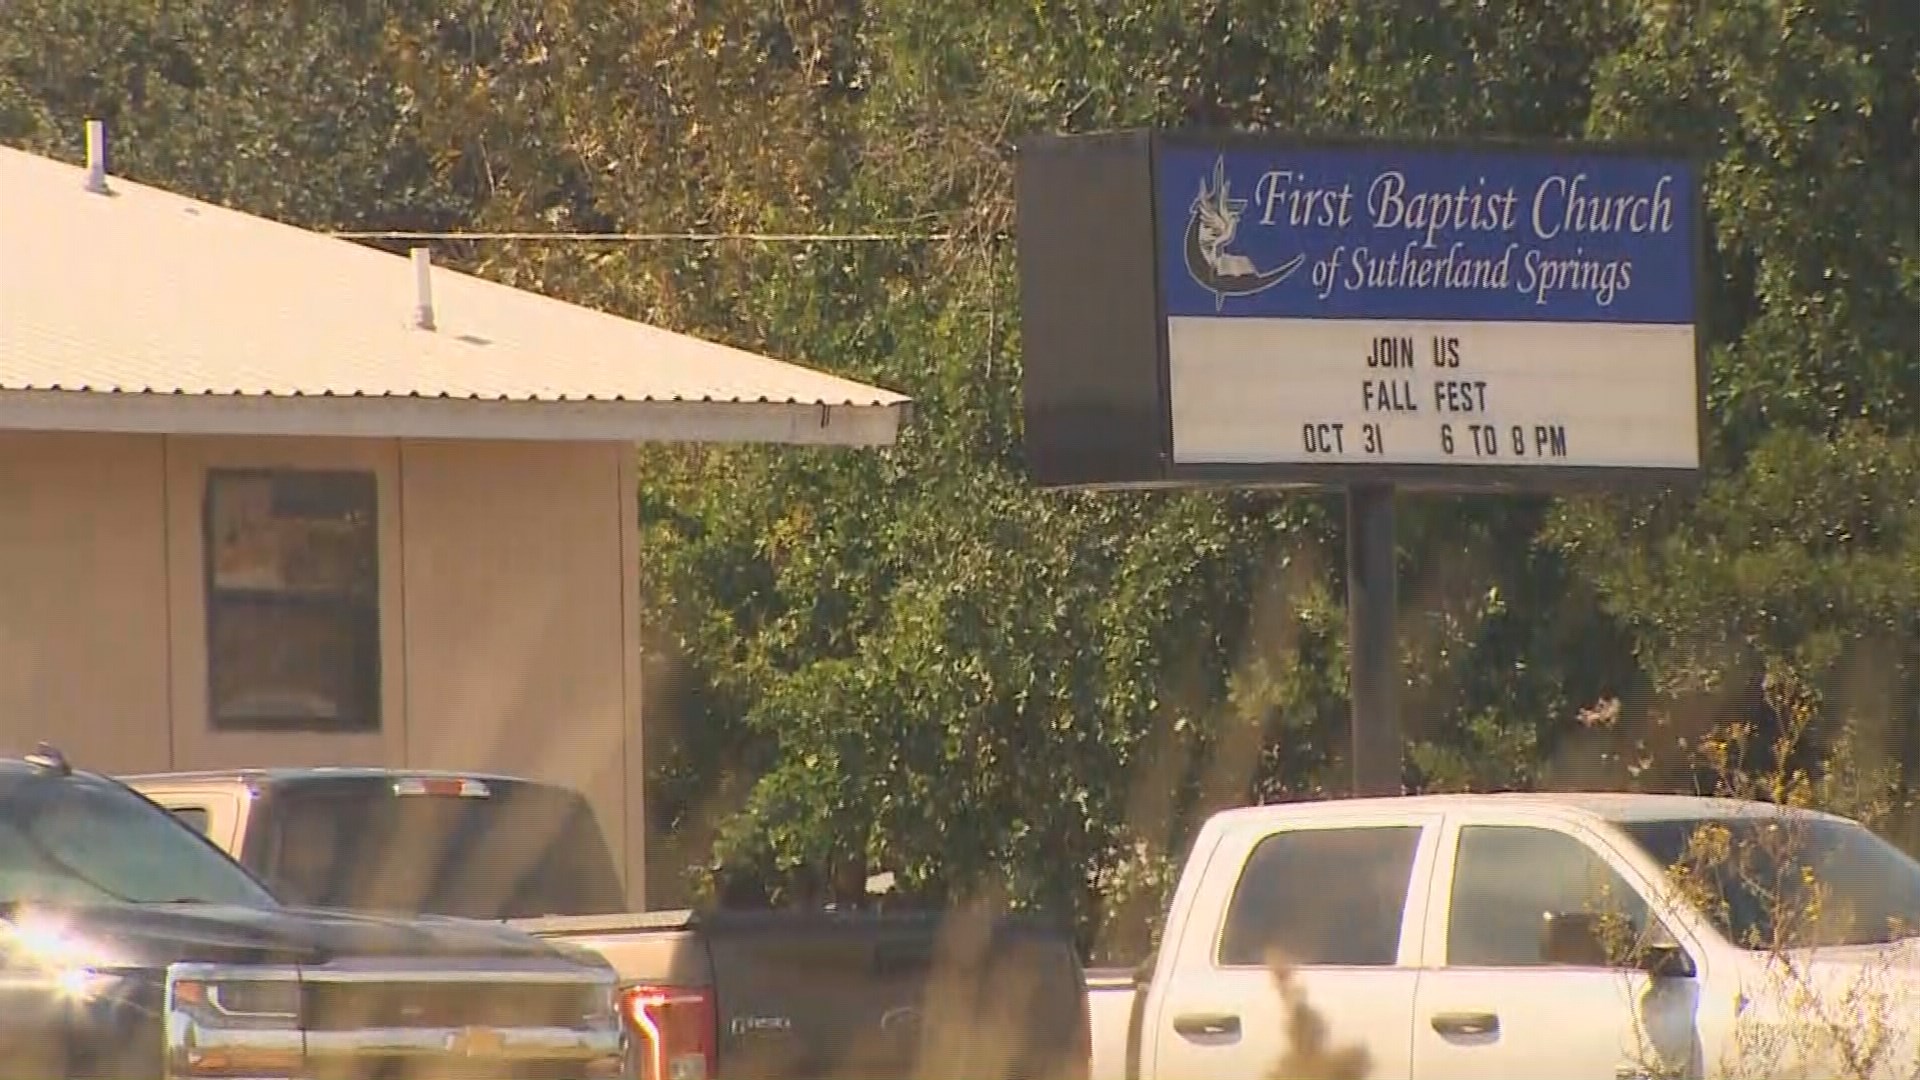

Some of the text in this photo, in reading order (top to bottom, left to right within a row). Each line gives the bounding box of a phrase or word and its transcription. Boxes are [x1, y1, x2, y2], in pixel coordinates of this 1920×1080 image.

[1255, 170, 1673, 248] First Baptist Church
[1312, 239, 1632, 306] of Sutherland Springs
[1367, 336, 1460, 368] JOIN US
[1363, 380, 1487, 412] FALL FEST
[1303, 423, 1567, 457] OCT 31 6 TO 8 PM
